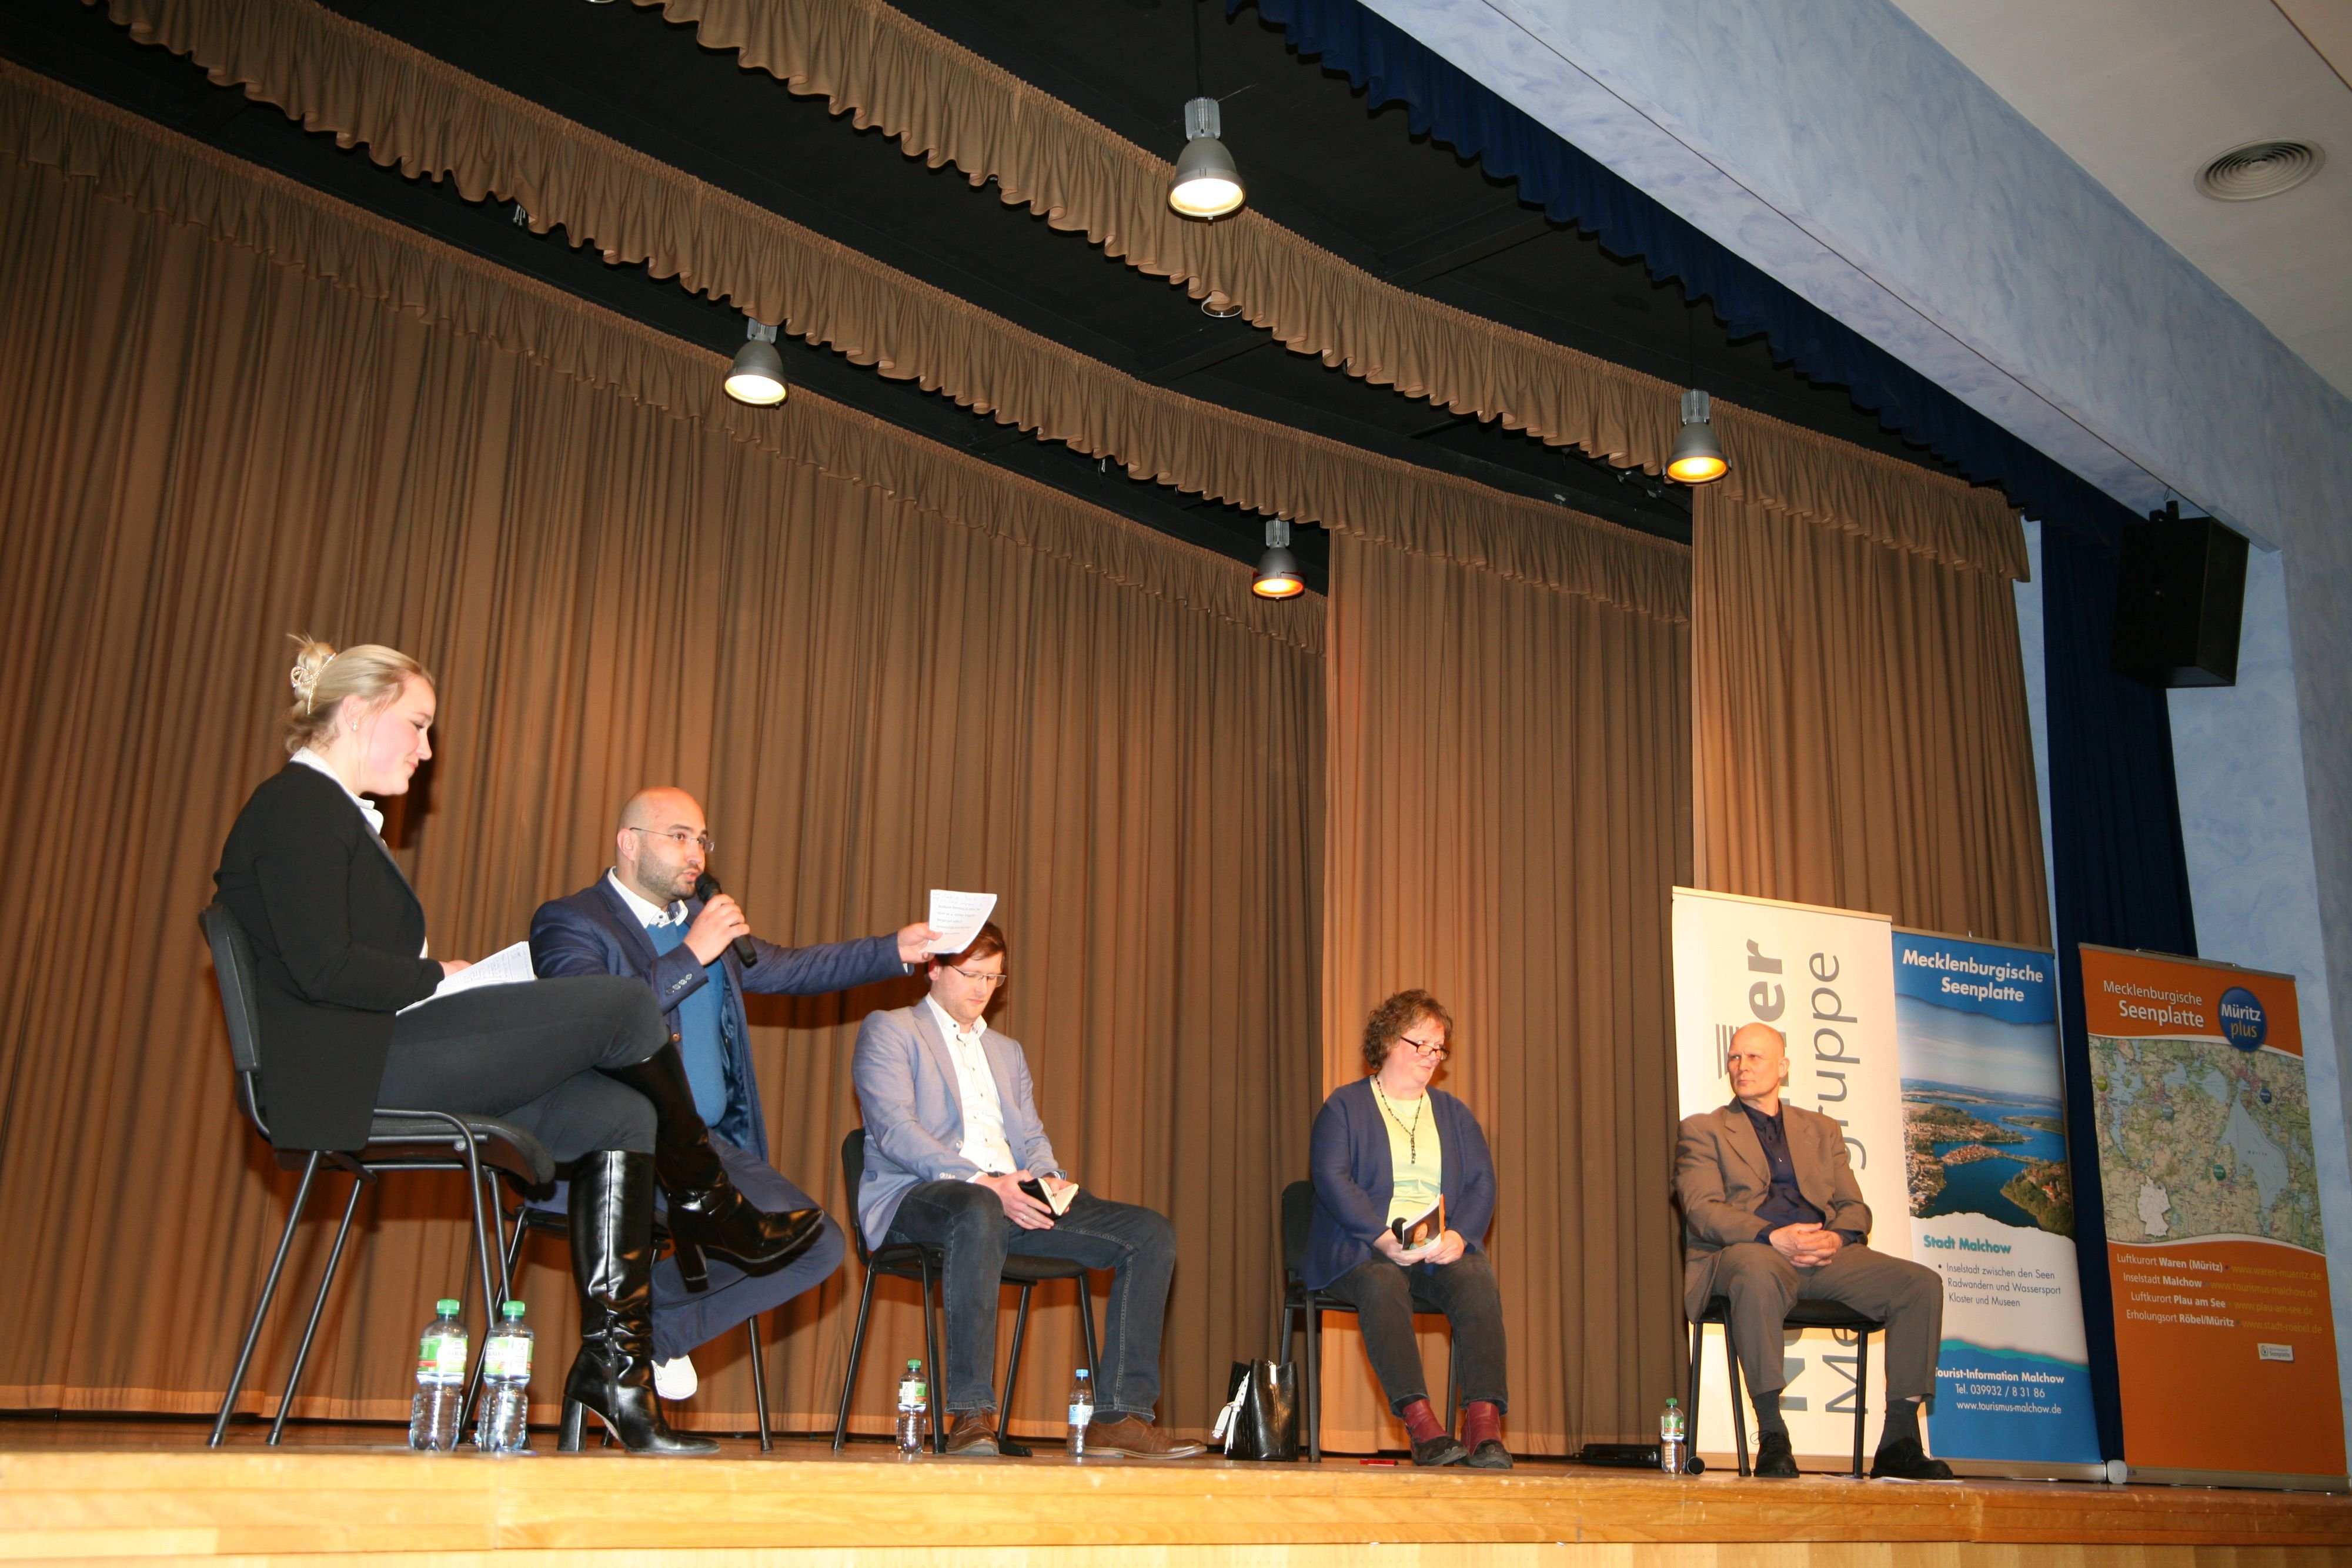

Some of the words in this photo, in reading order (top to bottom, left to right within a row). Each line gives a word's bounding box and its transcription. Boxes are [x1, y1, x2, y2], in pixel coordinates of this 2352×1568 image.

[1902, 949, 2043, 982] Mecklenburgische
[1942, 977, 2024, 1001] Seenplatte
[2103, 980, 2202, 1005] Mecklenburgische
[2119, 999, 2204, 1028] Seenplatte
[2221, 1003, 2261, 1022] Müritz
[2231, 1020, 2257, 1038] plus
[1923, 1235, 1956, 1249] Stadt
[1959, 1238, 2012, 1253] Malchow
[1947, 1263, 1980, 1274] Inselstadt
[1983, 1266, 2015, 1277] zwischen
[2018, 1268, 2032, 1278] den
[2036, 1270, 2054, 1279] Seen
[2117, 1253, 2157, 1266] Luftkurort
[2159, 1258, 2186, 1268] Waren
[2189, 1259, 2223, 1272] (Müritz)
[1948, 1278, 1993, 1290] Radwandern
[1996, 1281, 2010, 1291] und
[2012, 1283, 2060, 1296] Wassersport
[2123, 1272, 2160, 1284] Inselstadt
[2163, 1276, 2202, 1288] Malchow
[1949, 1293, 1973, 1303] Kloster
[1976, 1295, 1989, 1305] und
[1992, 1298, 2020, 1306] Museen
[2131, 1292, 2171, 1303] Luftkurort
[2174, 1295, 2193, 1306] Plau
[2195, 1298, 2208, 1306] am
[2210, 1298, 2226, 1308] See
[2126, 1309, 2177, 1323] Erholungsort
[2179, 1313, 2234, 1327] Röbel/Müritz
[2022, 1372, 2064, 1383] Malchow
[1955, 1383, 1968, 1394] Tel.
[1970, 1385, 2002, 1396] 039932
[2012, 1387, 2017, 1396] 8
[2020, 1388, 2030, 1397] 31
[2034, 1388, 2045, 1398] 86
